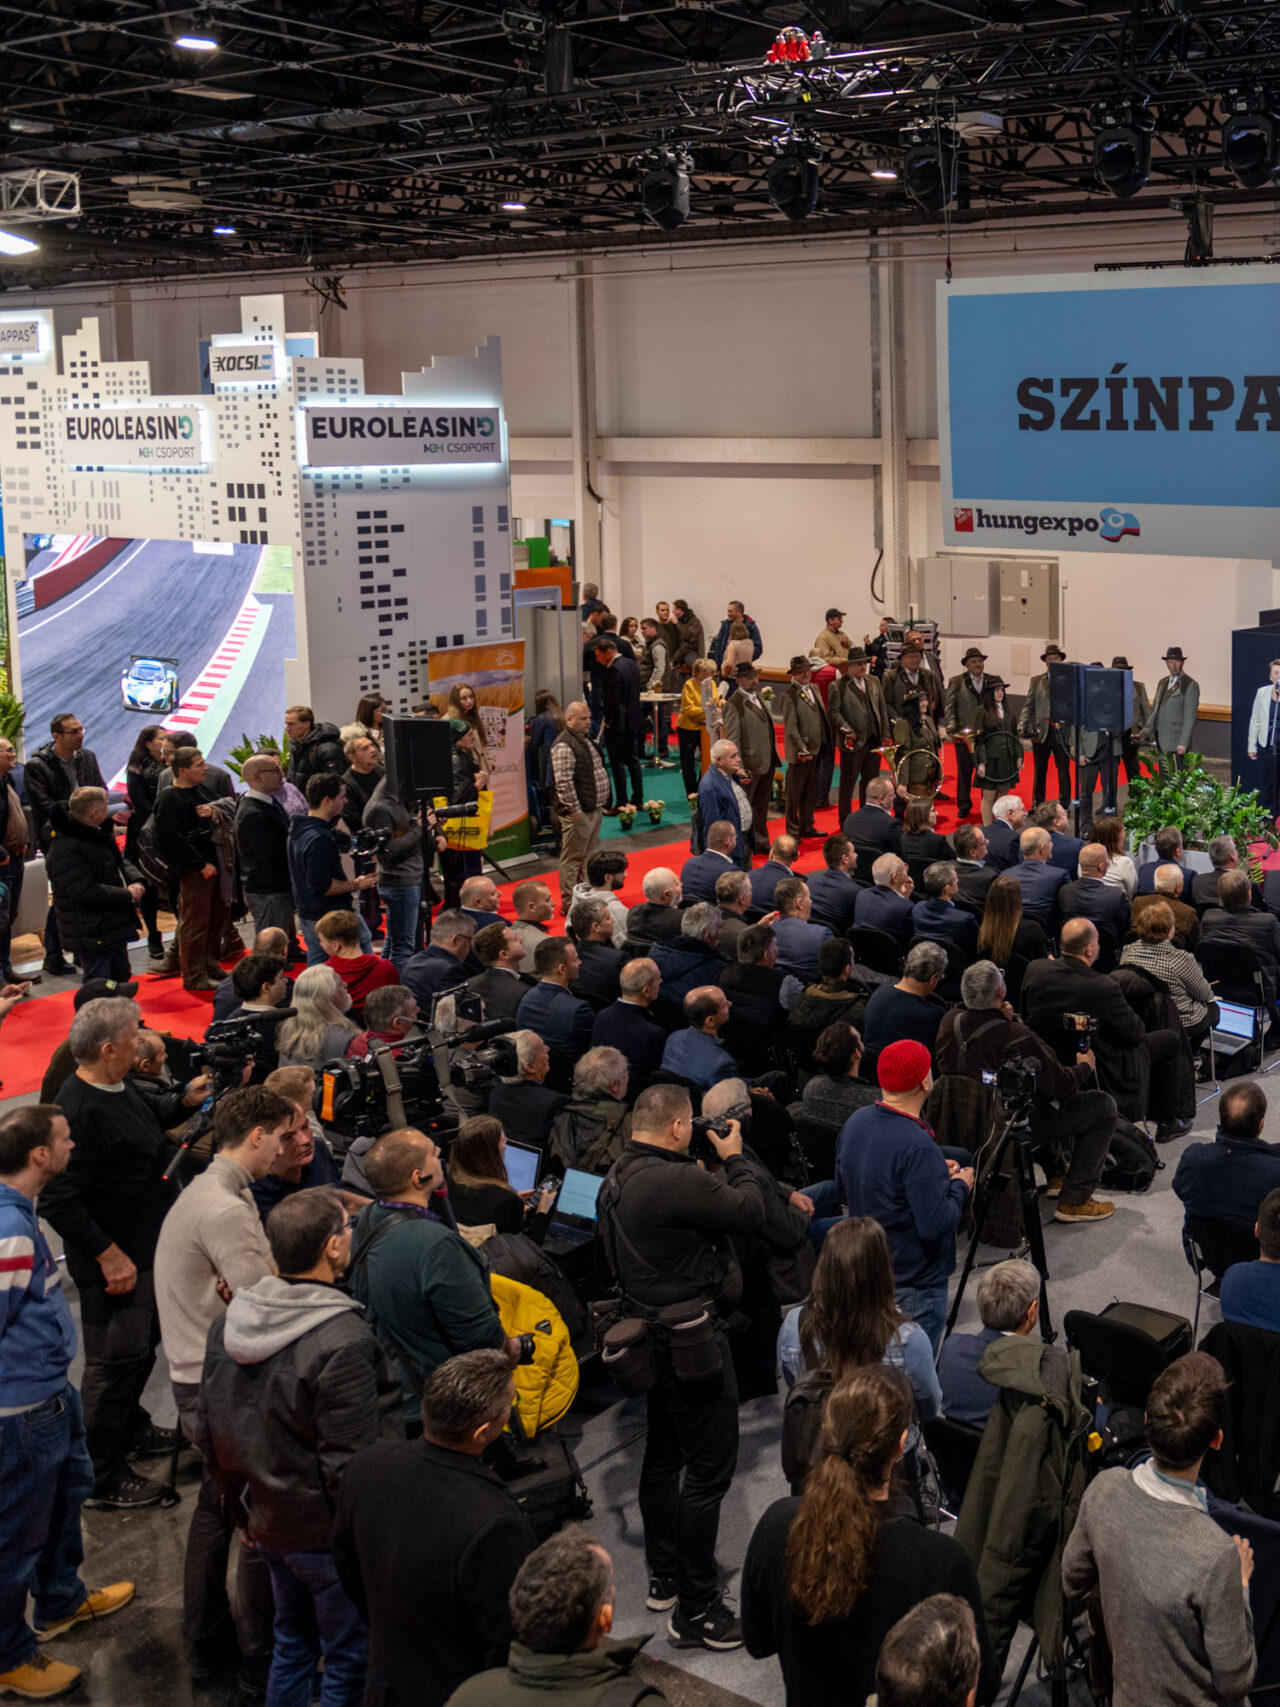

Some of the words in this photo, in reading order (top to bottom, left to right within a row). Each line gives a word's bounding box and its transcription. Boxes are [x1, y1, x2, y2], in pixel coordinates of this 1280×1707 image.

[0, 329, 30, 342] APPAS
[66, 415, 194, 440] EUROLEASING
[312, 416, 495, 439] EUROLEASING
[156, 446, 195, 458] CSOPORT
[446, 442, 496, 453] CSOPORT
[976, 508, 1099, 536] hungexpo
